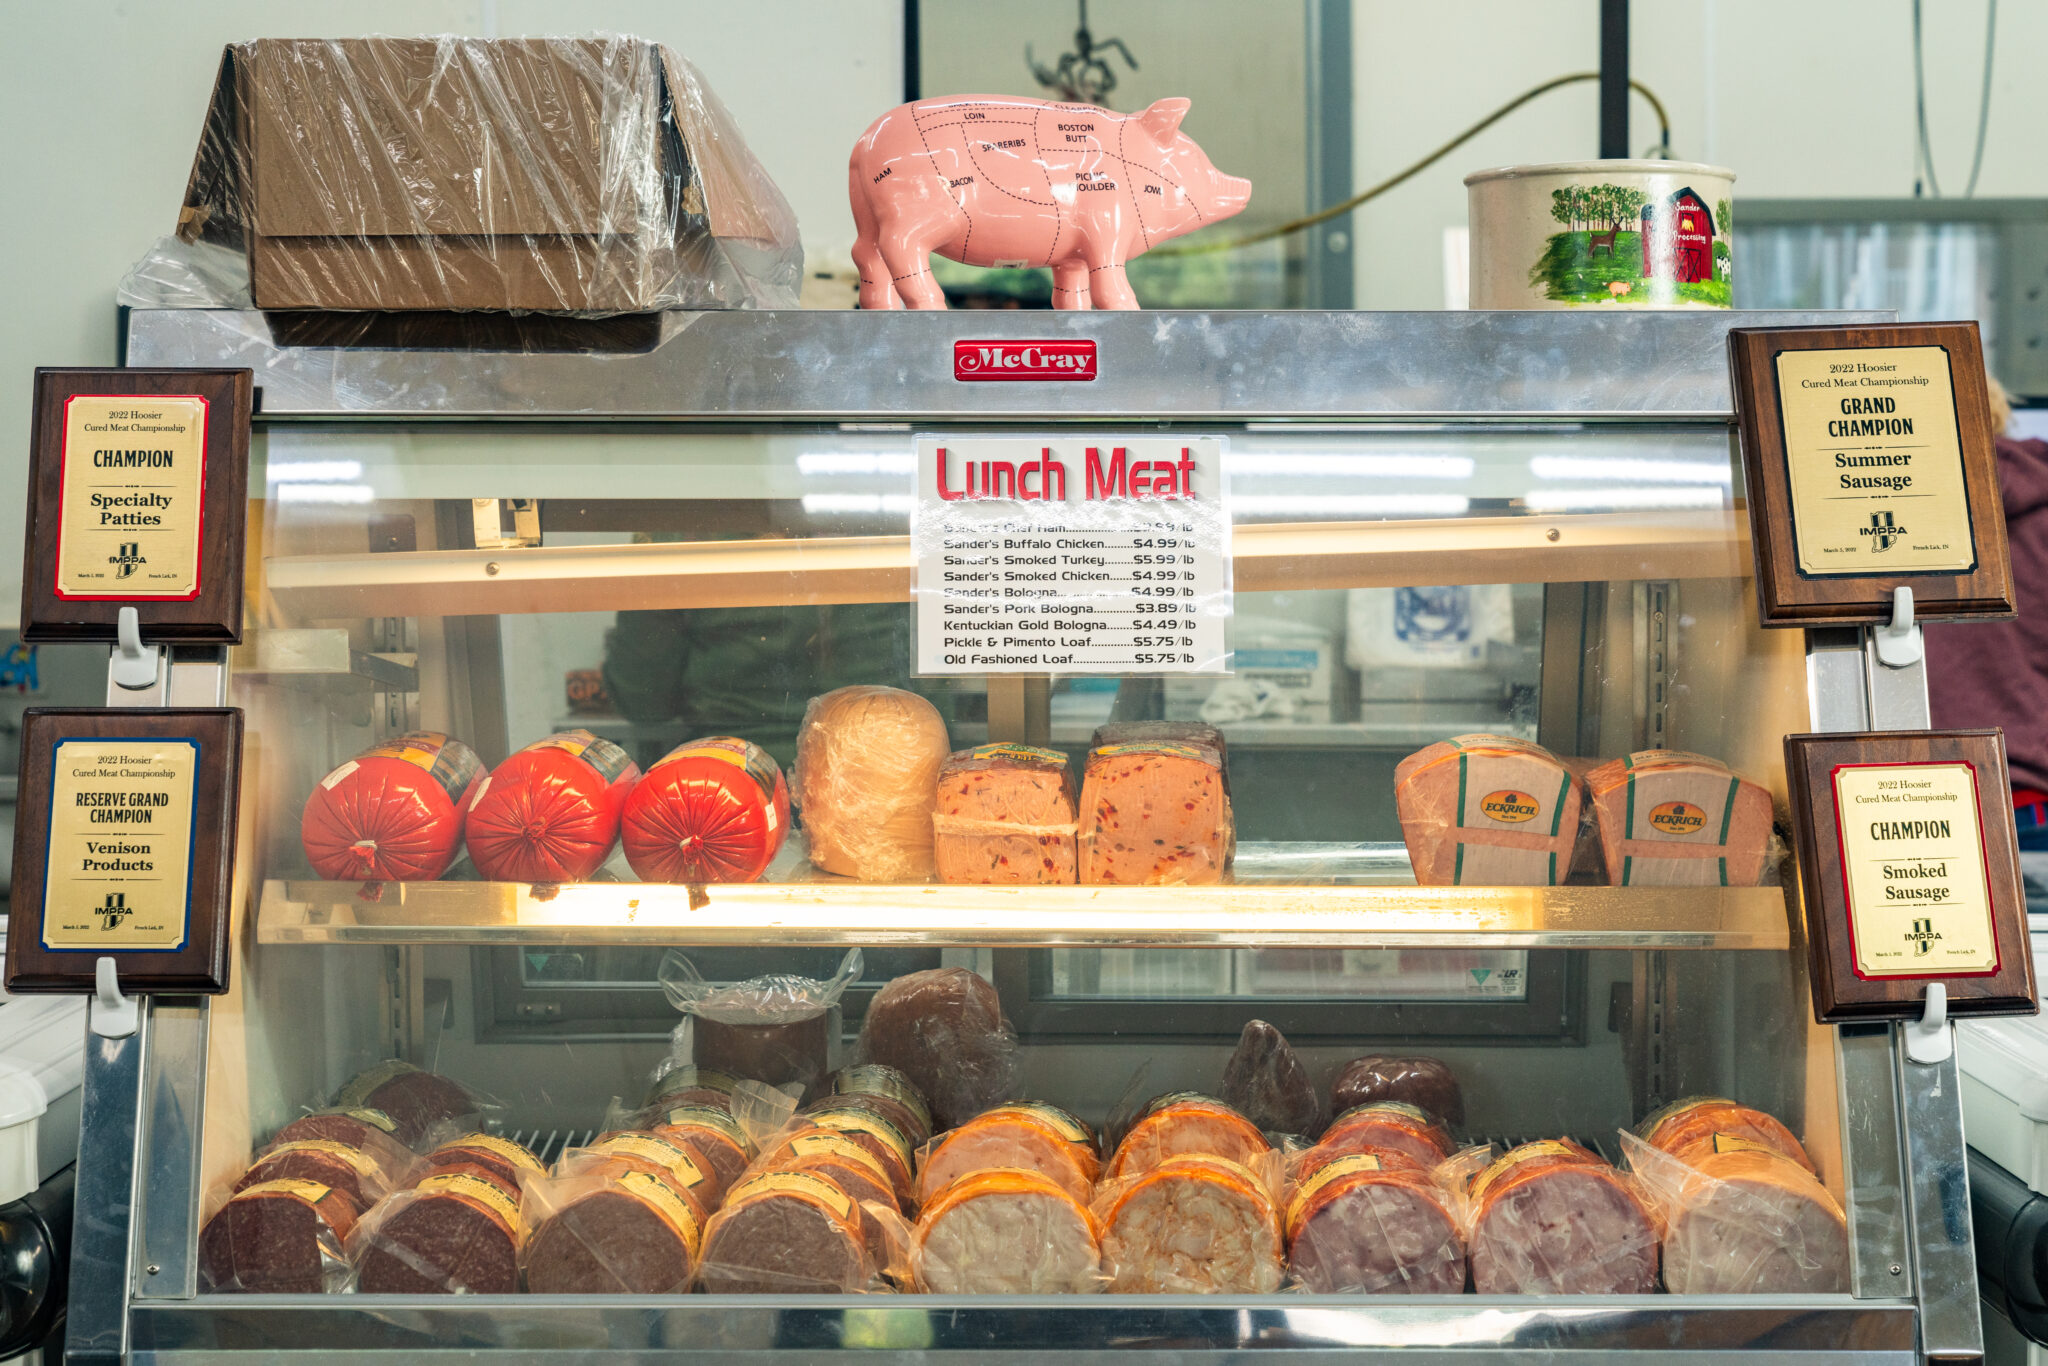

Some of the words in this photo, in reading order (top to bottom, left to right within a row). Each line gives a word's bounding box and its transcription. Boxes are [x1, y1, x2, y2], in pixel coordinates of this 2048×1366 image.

[1058, 124, 1094, 132] BOSTON
[1066, 135, 1087, 143] BUTT
[873, 167, 892, 184] HAM
[950, 176, 974, 188] BACON
[1675, 202, 1700, 211] Sander
[1673, 231, 1706, 244] Processing
[959, 347, 1092, 374] McCray
[1830, 364, 1854, 373] 2022
[1857, 363, 1897, 372] Hoosier
[1802, 379, 1831, 388] Cured
[1834, 378, 1858, 387] Meat
[1860, 376, 1929, 387] Championship
[1841, 397, 1896, 415] GRAND
[109, 411, 129, 419] 2022
[131, 410, 162, 419] Hoosier
[84, 424, 108, 432] Cured
[110, 424, 129, 432] Meat
[131, 424, 186, 433] Championship
[1828, 418, 1914, 437] CHAMPION
[94, 450, 173, 468] CHAMPION
[1835, 453, 1912, 468] Summer
[936, 447, 1066, 501] Lunch
[1085, 447, 1196, 501] Meat
[1840, 473, 1912, 490] Sausage
[90, 493, 173, 510] Specialty
[100, 512, 161, 526] Patties
[1860, 527, 1907, 535] IMPPA
[944, 540, 999, 549] Sander's
[1004, 539, 1051, 549] Buffalo
[1056, 539, 1105, 549] Chicken
[1133, 538, 1196, 549] $4.99/lb
[109, 556, 147, 564] IMPPA
[944, 555, 999, 565] Sander's
[1004, 555, 1057, 565] Smoked
[1061, 555, 1105, 567] Turkey
[1133, 554, 1195, 565] $5.99/lb
[944, 572, 999, 581] Sander's
[1004, 572, 1057, 581] Smoked
[1061, 571, 1110, 581] Chicken
[1132, 571, 1195, 581] $4.99/lb
[944, 588, 999, 597] Sander's
[1004, 588, 1057, 599] Bologna
[1131, 587, 1194, 597] $4.99/lb
[944, 604, 1000, 614] Sander's
[1004, 604, 1036, 613] Pork
[1041, 604, 1094, 615] Bologna
[1135, 603, 1196, 613] $3.89/lb
[944, 620, 1013, 630] Kentuckian
[1018, 620, 1049, 630] Gold
[1054, 620, 1107, 632] Bologna
[1132, 619, 1196, 630] $4.49/lb
[944, 637, 982, 647] Pickle
[987, 637, 998, 647] &
[1003, 637, 1056, 647] Pimento
[1060, 637, 1092, 647] Loaf
[1133, 636, 1193, 647] $5.75/lb
[944, 654, 966, 664] Old
[971, 654, 1038, 664] Fashioned
[1042, 654, 1073, 664] Loaf
[1134, 653, 1195, 664] $5.75/lb
[98, 756, 118, 764] 2022
[119, 755, 152, 764] Hoosier
[72, 769, 96, 777] Cured
[99, 769, 118, 777] Meat
[120, 769, 176, 779] Championship
[1878, 781, 1898, 789] 2022
[1900, 780, 1931, 789] Hoosier
[76, 792, 127, 806] RESERVE
[129, 792, 169, 807] GRAND
[1856, 795, 1880, 803] Cured
[1881, 794, 1901, 803] Meat
[1902, 792, 1958, 803] Championship
[1485, 803, 1534, 815] ECKRICH
[90, 809, 152, 823] CHAMPION
[1653, 814, 1702, 826] ECKRICH
[1870, 820, 1951, 840] CHAMPION
[86, 842, 151, 854] Venison
[82, 859, 153, 871] Products
[1883, 863, 1948, 880] Smoked
[1885, 885, 1950, 902] Sausage
[95, 907, 133, 915] IMPPA
[1904, 933, 1943, 941] IMPPA
